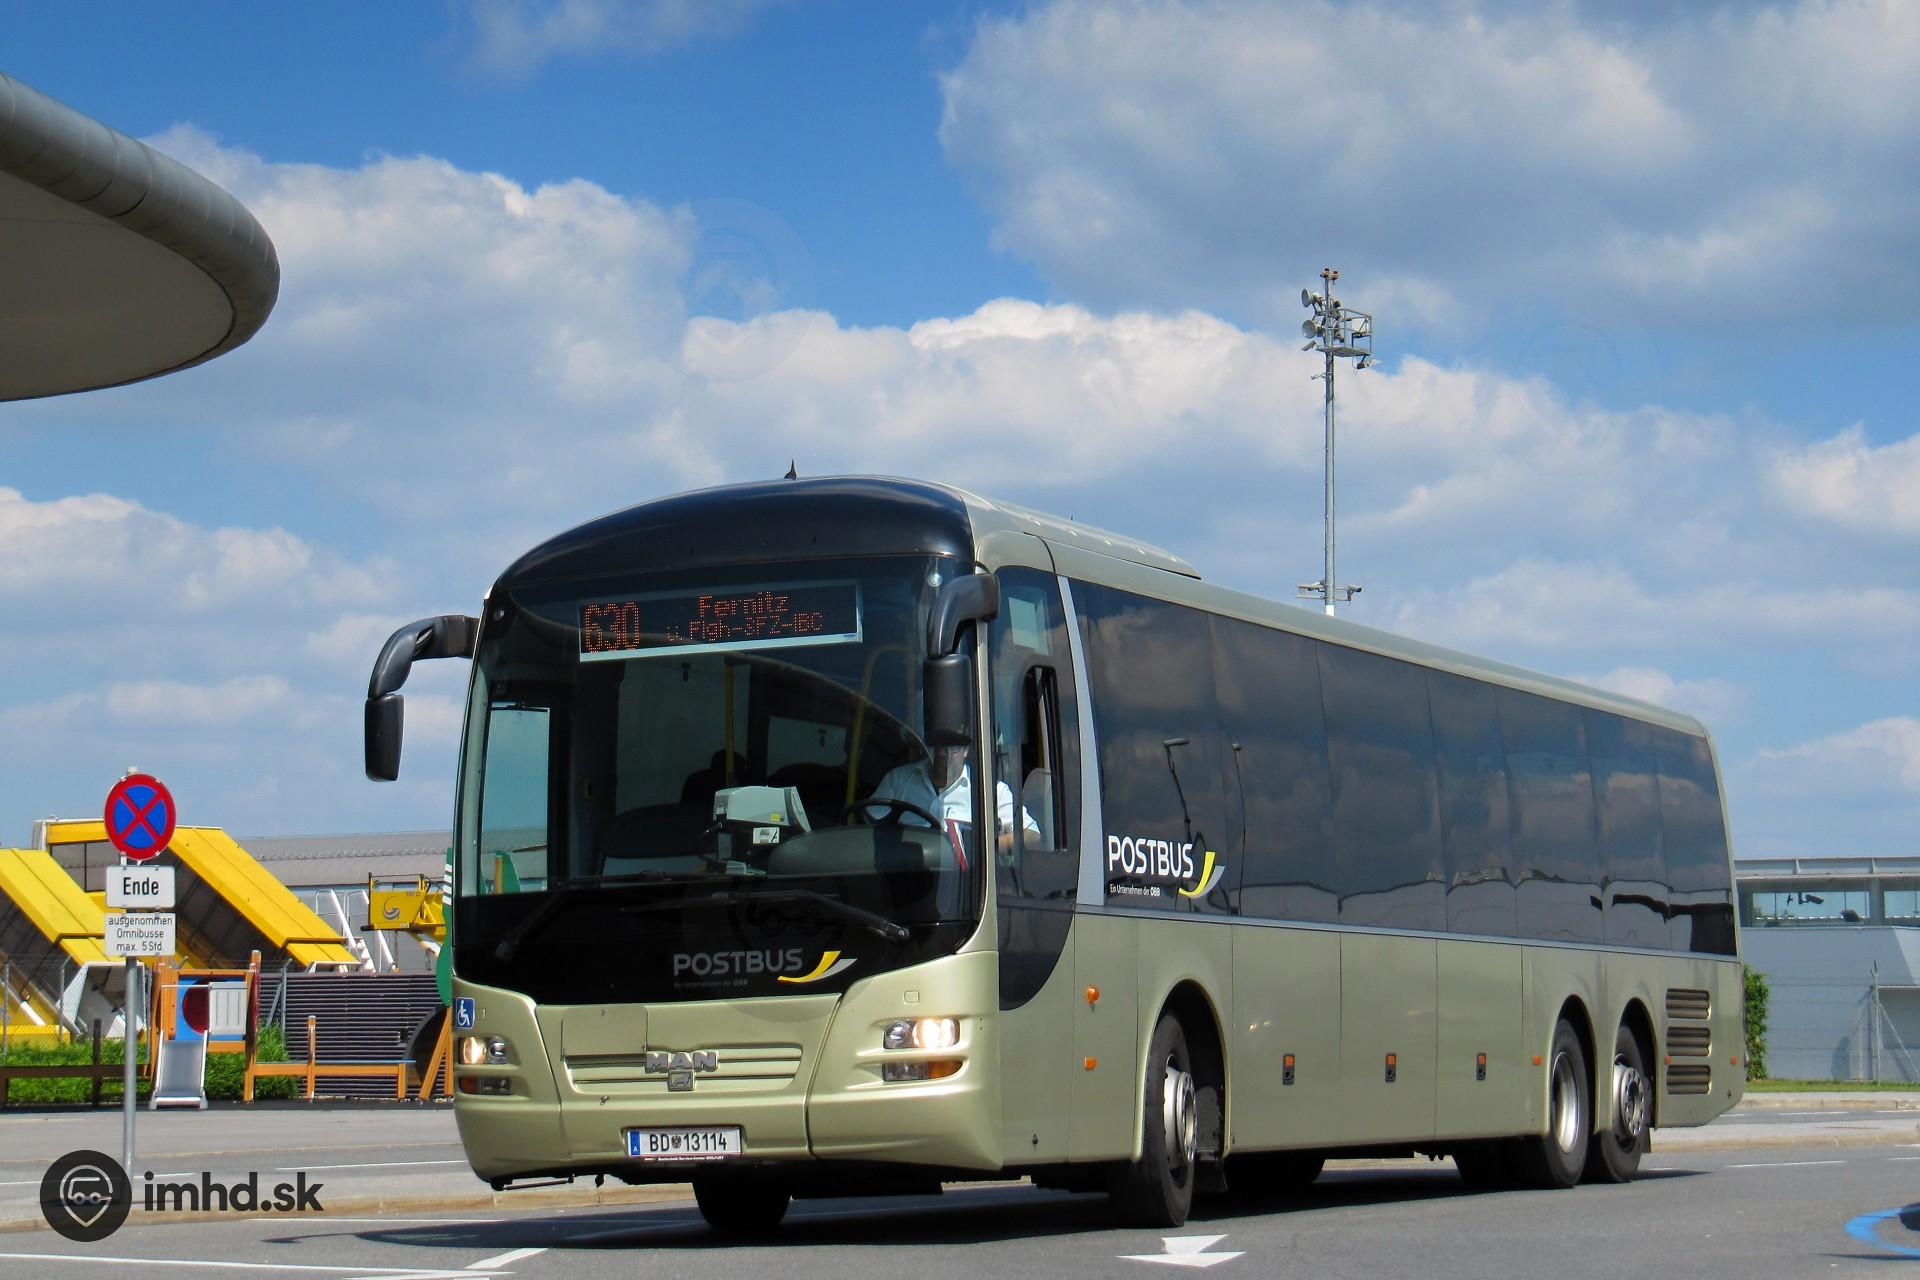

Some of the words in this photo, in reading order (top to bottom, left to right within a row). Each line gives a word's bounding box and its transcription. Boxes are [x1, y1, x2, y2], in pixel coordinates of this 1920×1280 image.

[700, 591, 788, 617] Fernitz
[585, 602, 640, 653] 630
[1108, 835, 1194, 878] POSTBUS
[123, 877, 159, 896] Ende
[108, 917, 173, 927] ausgenommen
[116, 928, 165, 938] Omnibusse
[673, 948, 803, 976] POSTBUS
[645, 1051, 720, 1074] MAN
[650, 1133, 670, 1152] BD
[683, 1132, 727, 1151] 13114
